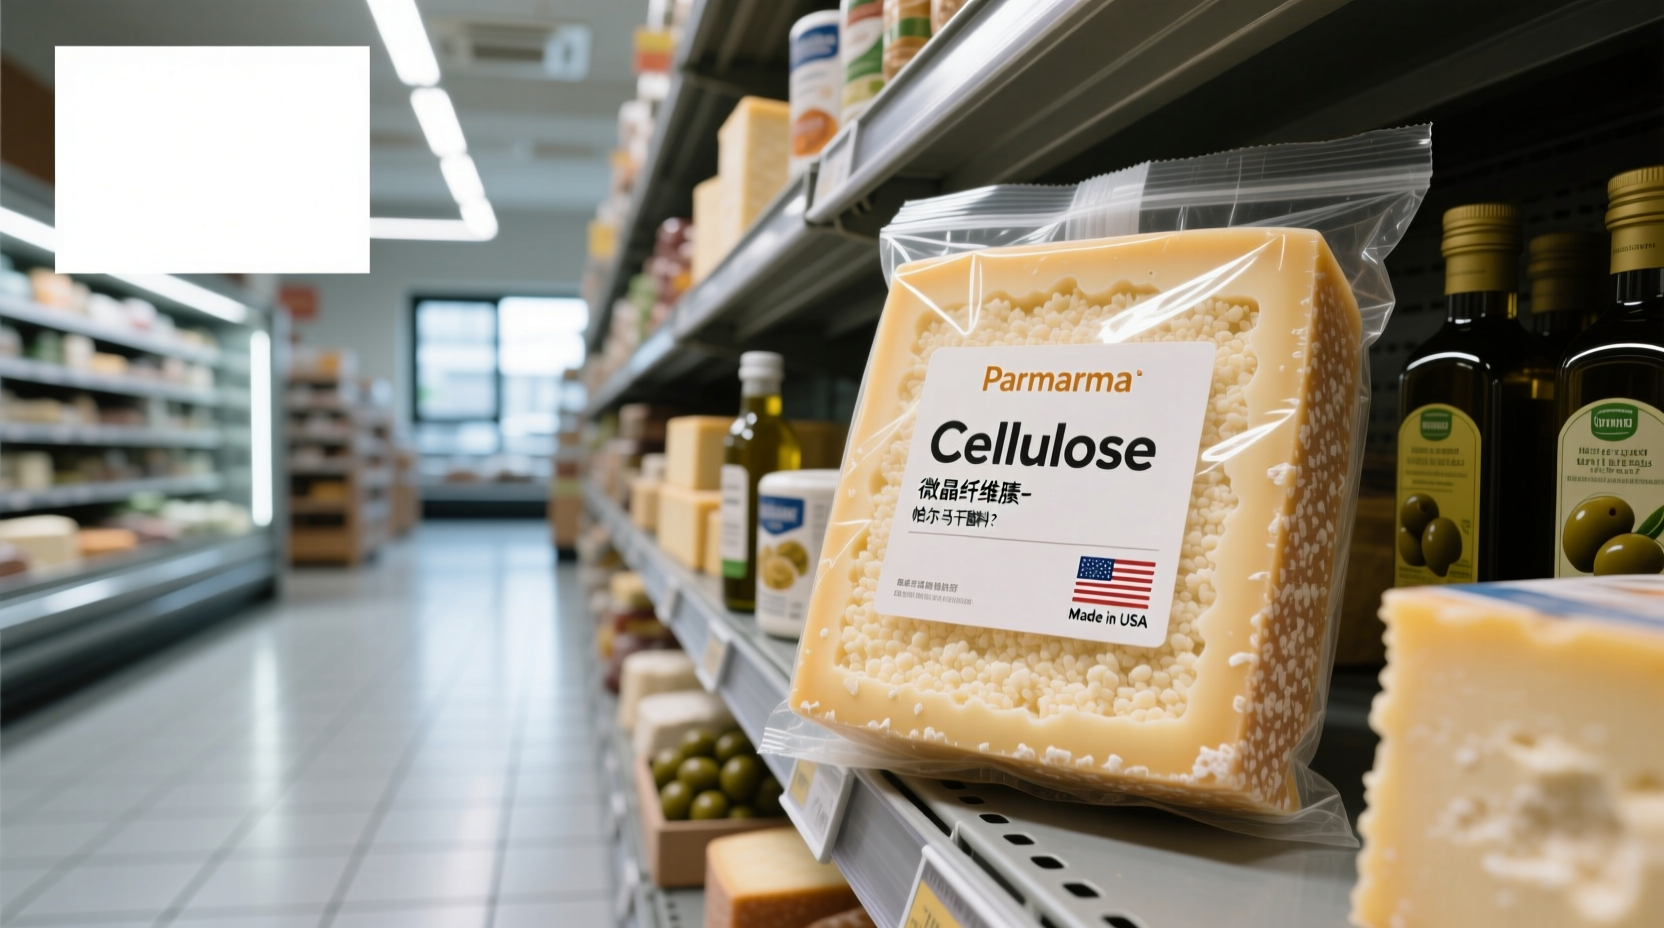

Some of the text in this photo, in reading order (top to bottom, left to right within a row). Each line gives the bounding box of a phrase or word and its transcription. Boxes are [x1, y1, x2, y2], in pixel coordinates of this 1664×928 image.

[982, 366, 1133, 393] Parmarma
[930, 420, 1157, 472] Cellulose
[1068, 607, 1148, 629] Made in USA
